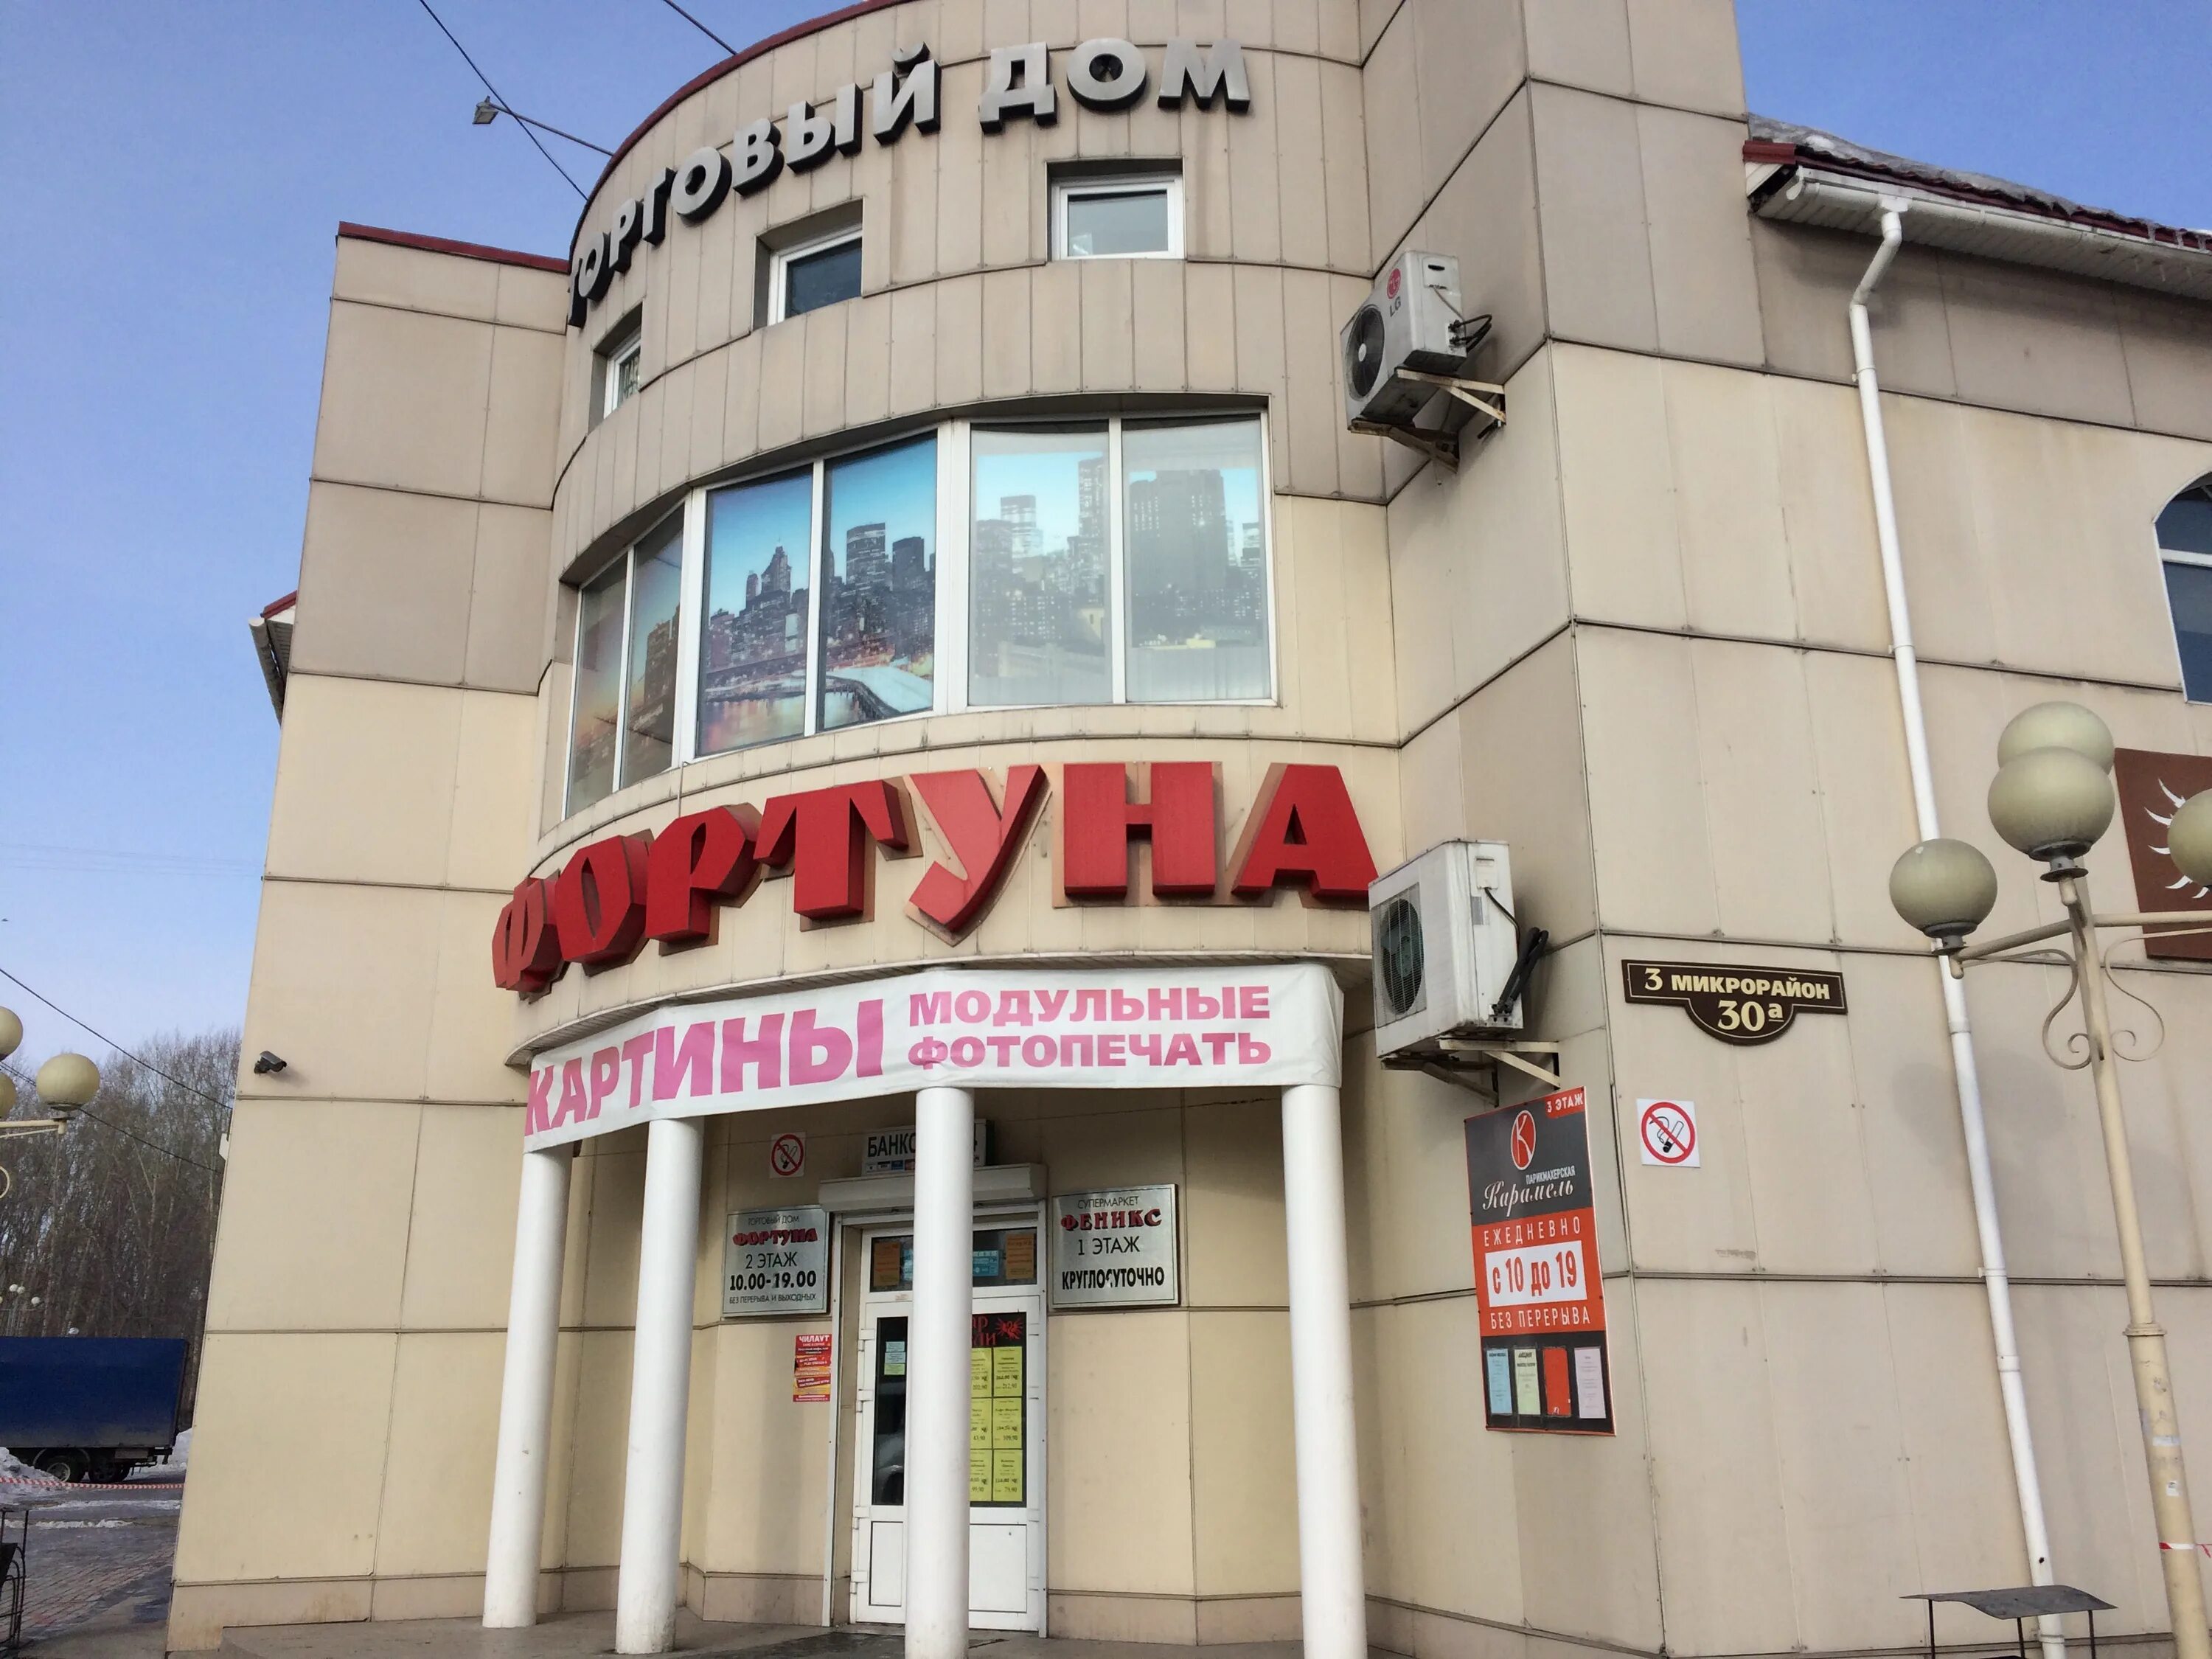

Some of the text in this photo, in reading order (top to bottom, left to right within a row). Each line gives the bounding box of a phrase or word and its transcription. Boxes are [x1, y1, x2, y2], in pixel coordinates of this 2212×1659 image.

[978, 38, 1251, 134] ДОМ
[1389, 296, 1401, 317] LG
[491, 761, 1379, 992] ФОРТУНА
[1644, 967, 1830, 1000] 3 МИКРОРАЙОН
[909, 986, 1270, 1027] МОДУЛЬНЫЕ
[908, 1032, 1272, 1070] ФОТОПЕЧАТЬ
[524, 999, 883, 1136] КАРТИНЫ
[1547, 1093, 1584, 1113] 3 ЭТАЖ
[867, 1133, 917, 1158] БАНКО
[1526, 1165, 1576, 1185] ПАРИКМАХЕРСКАЯ
[1078, 1196, 1139, 1209] СУПЕРМАРКЕТ
[1482, 1180, 1573, 1217] Карамель
[782, 1215, 799, 1224] ДОМ
[1061, 1208, 1163, 1231] ФЕНИКС
[733, 1228, 818, 1246] ФОРТУНА
[1484, 1216, 1581, 1248] ЕЖЕДНЕВНО
[1078, 1236, 1140, 1256] 1 ЭТАЖ
[745, 1251, 798, 1269] 2 ЭТАЖ
[730, 1270, 817, 1290] 10.00-19.00
[1062, 1266, 1165, 1290] КРУГЛОСУТОЧНО
[1505, 1256, 1524, 1293] 10
[1531, 1261, 1551, 1296] до
[1556, 1250, 1577, 1288] 19
[729, 1296, 739, 1304] БЕЗ
[740, 1295, 769, 1304] ПЕРЕРЫВА
[778, 1293, 816, 1302] ВЫХОДНЫХ
[1490, 1306, 1590, 1329] БЕЗ ПЕРЕРЫВА
